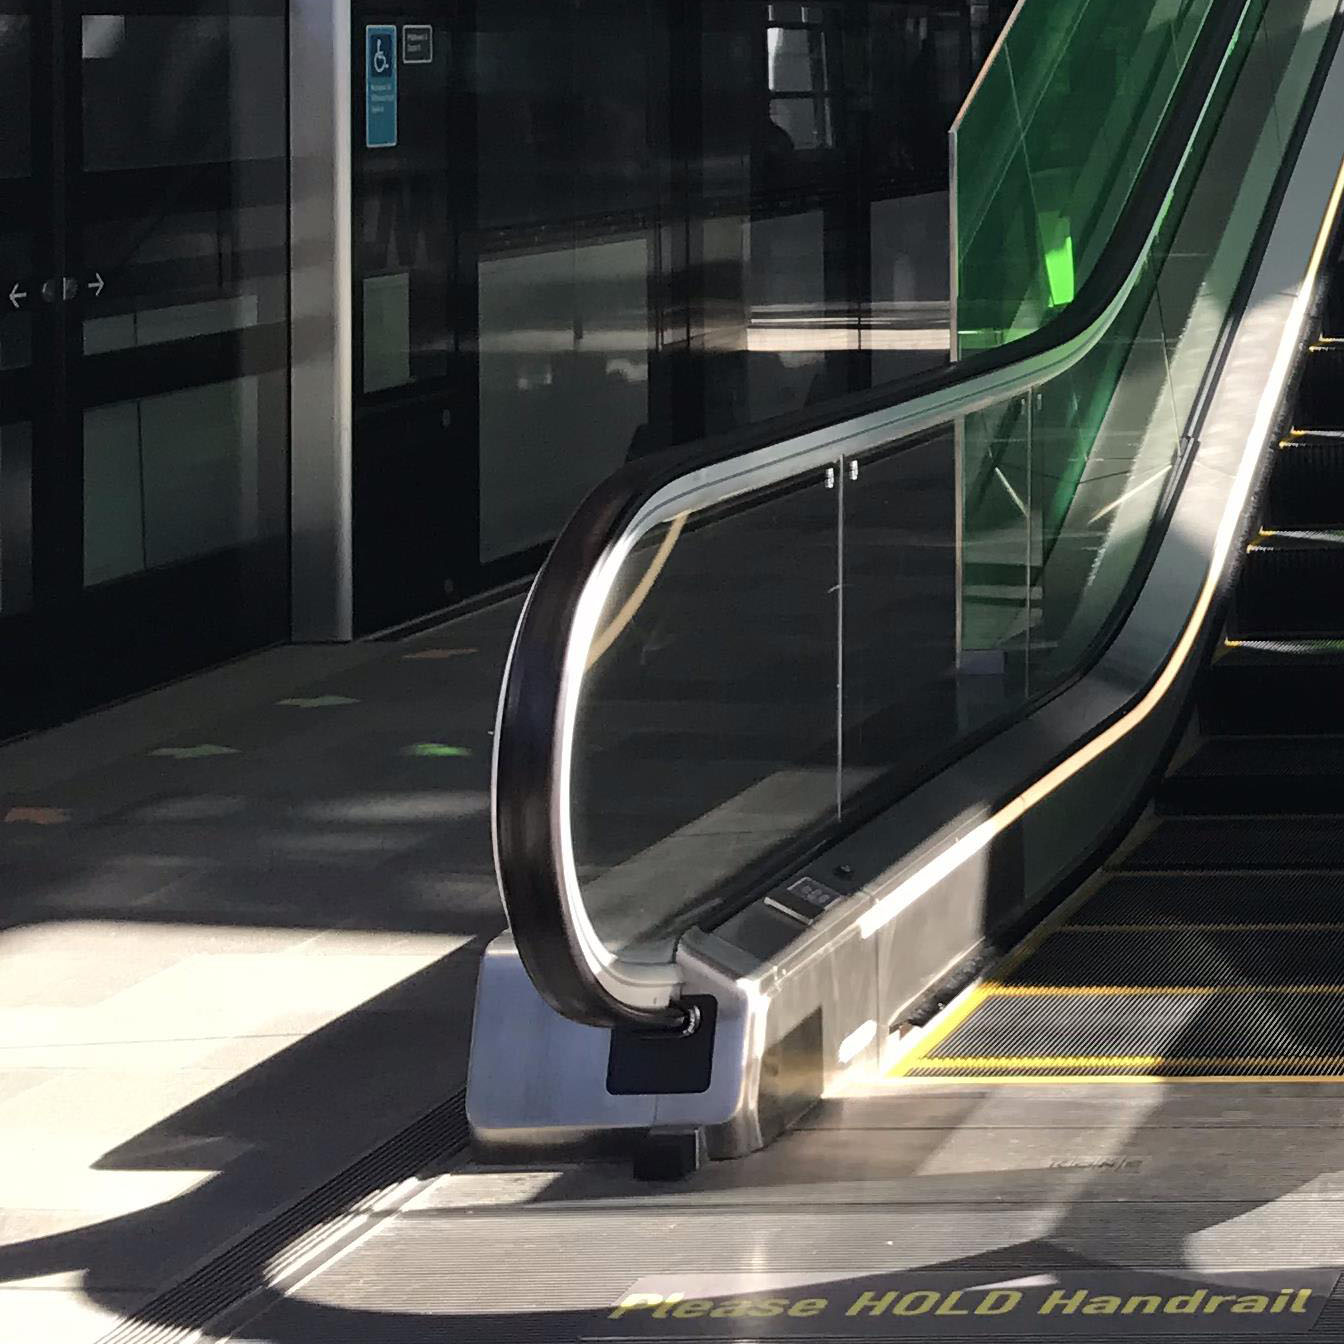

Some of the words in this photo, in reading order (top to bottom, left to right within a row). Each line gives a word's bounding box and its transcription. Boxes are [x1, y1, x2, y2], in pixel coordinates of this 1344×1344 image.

[609, 1291, 828, 1320] Please
[846, 1290, 1019, 1316] HOLD
[1038, 1288, 1313, 1314] Handrail
